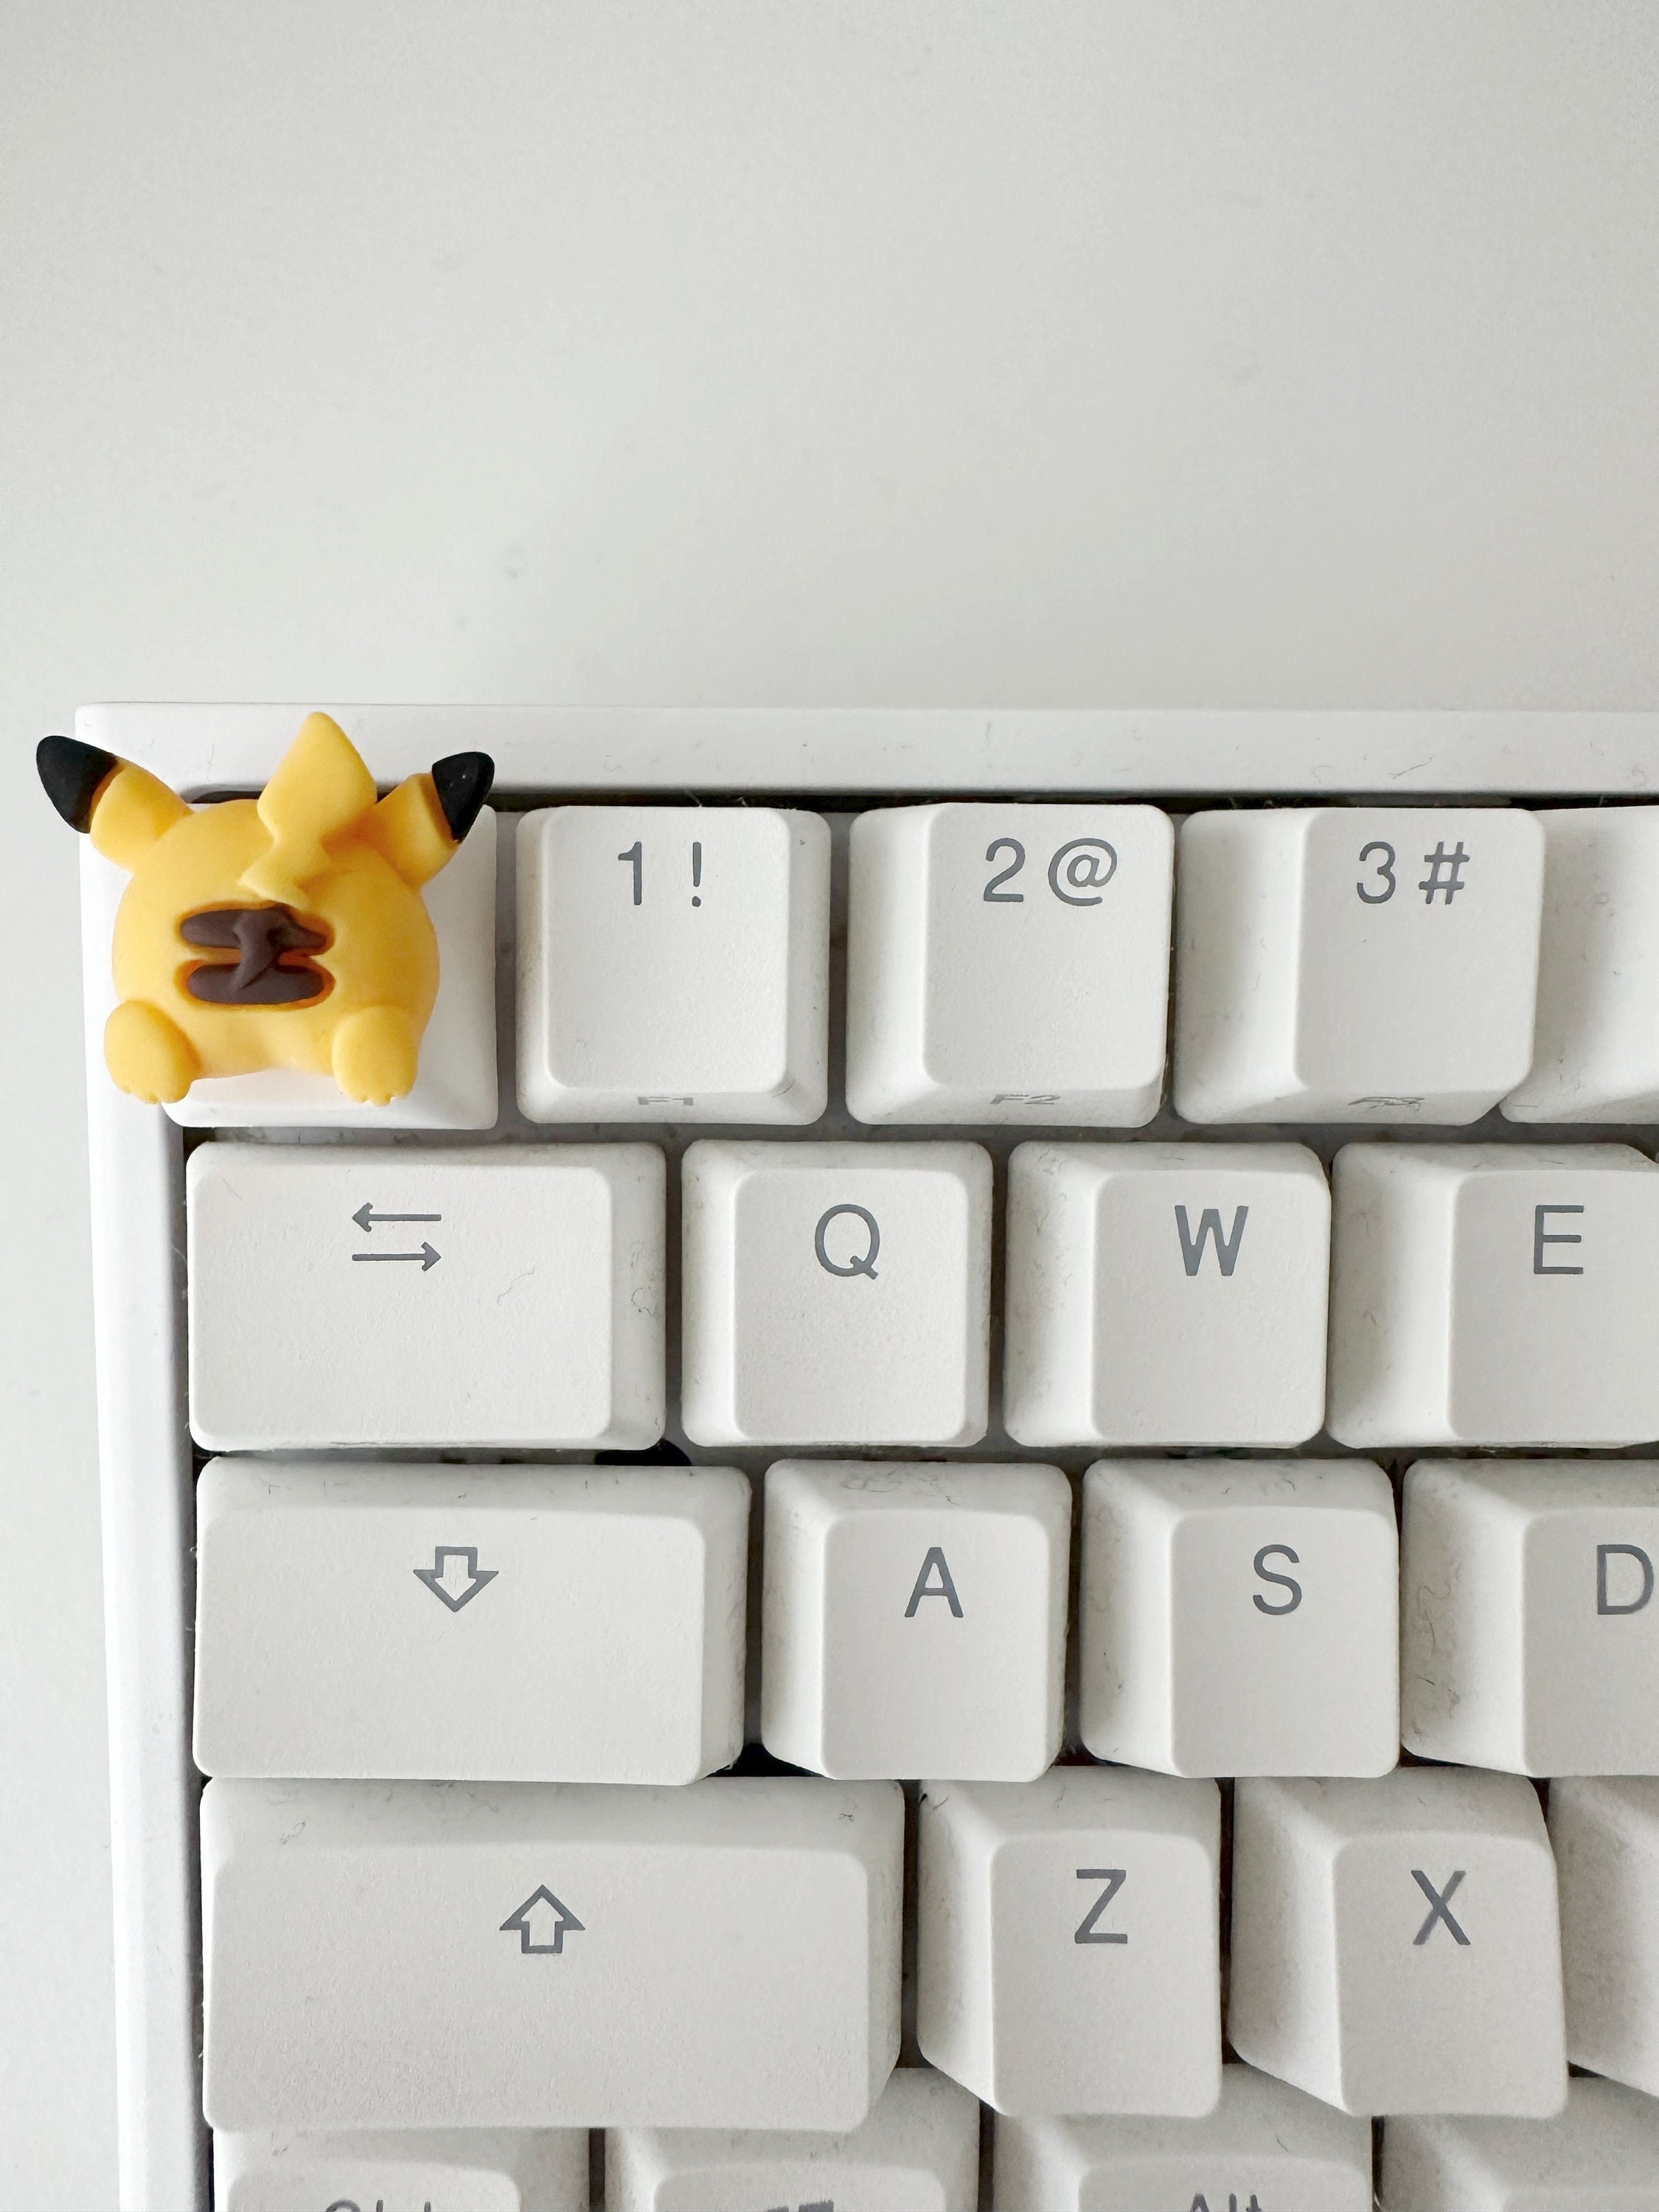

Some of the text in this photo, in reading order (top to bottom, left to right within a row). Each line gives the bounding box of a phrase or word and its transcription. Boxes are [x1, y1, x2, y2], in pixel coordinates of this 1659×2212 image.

[814, 1203, 880, 1280] Q
[1174, 1205, 1249, 1277] W
[1533, 1204, 1585, 1276] E
[904, 1546, 964, 1618] A
[1252, 1543, 1303, 1616] S
[1595, 1543, 1655, 1615] D
[1074, 1868, 1128, 1945] Z
[1410, 1869, 1472, 1947] X
